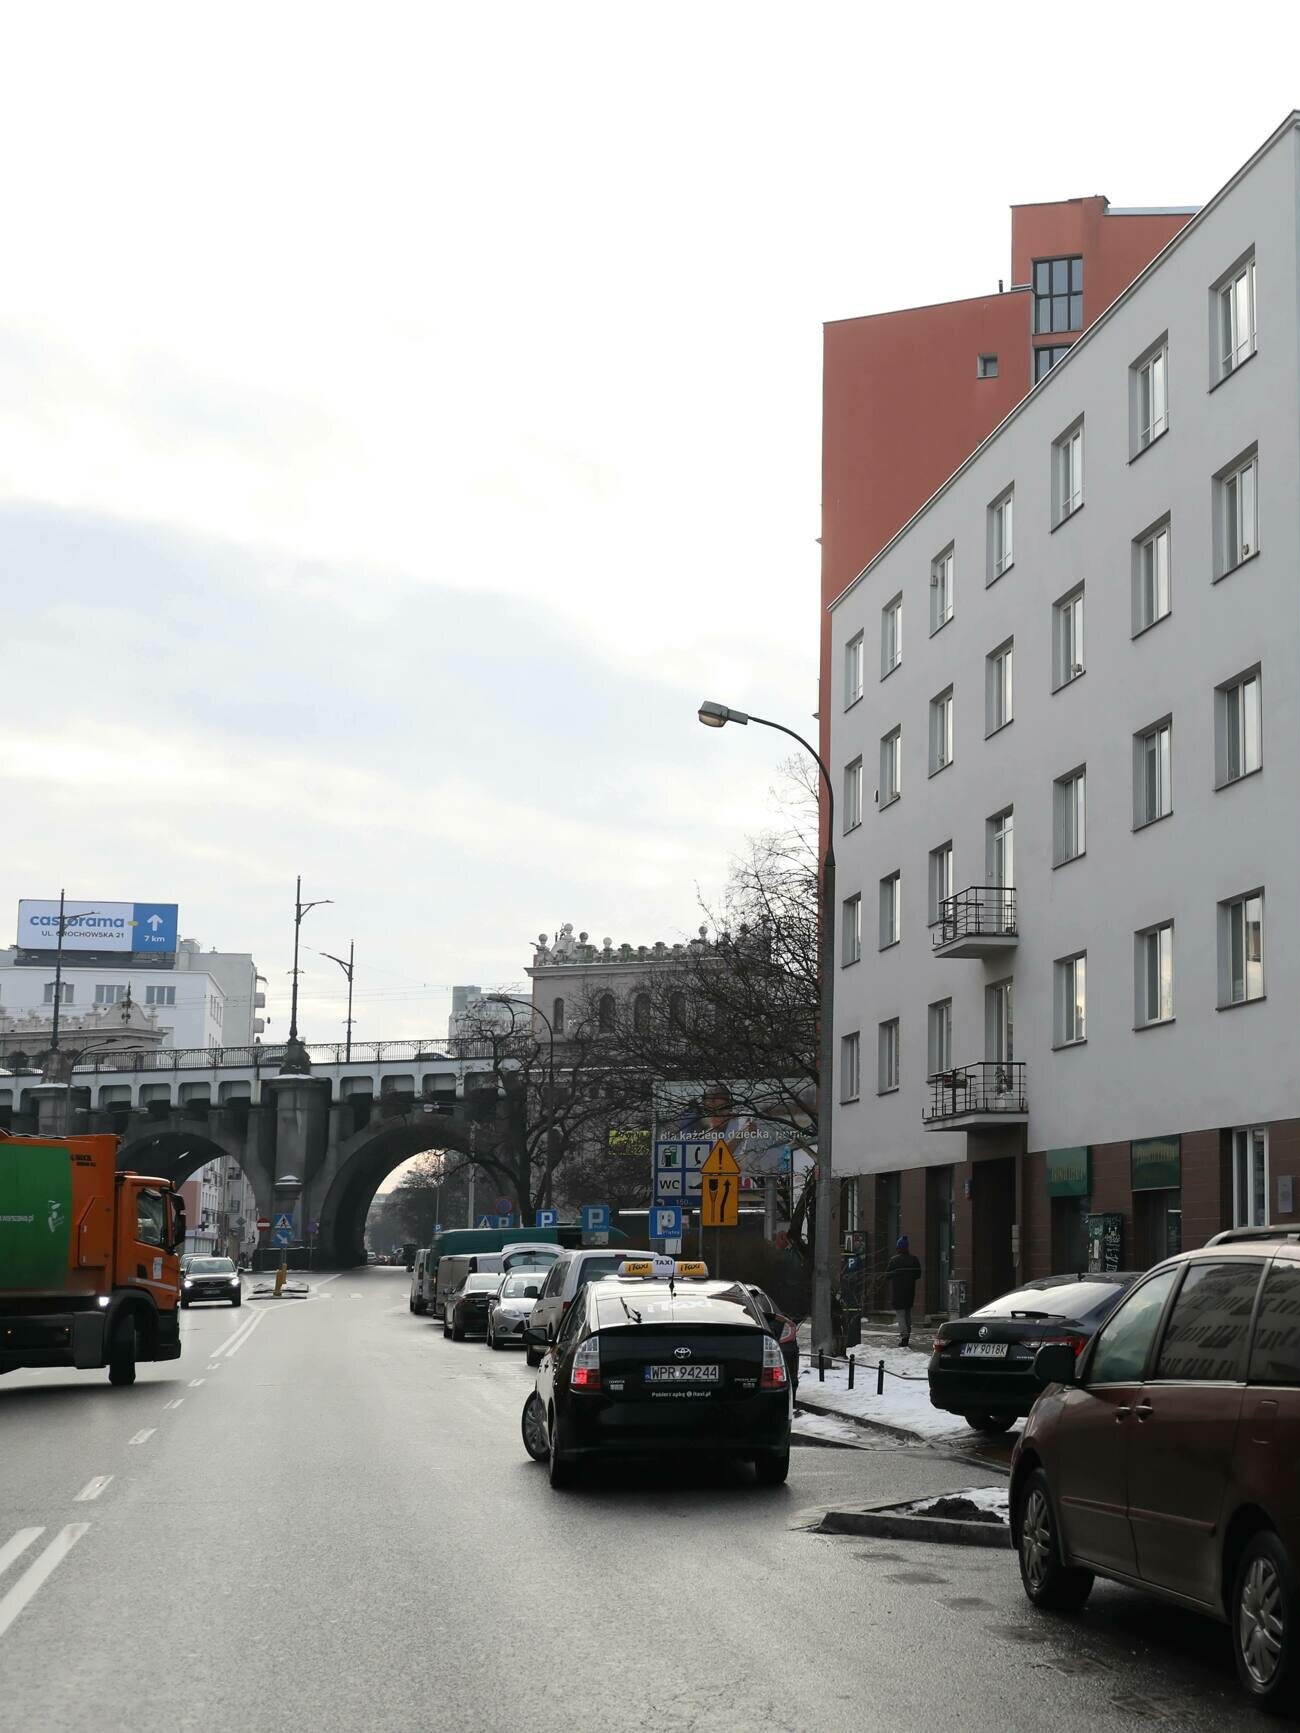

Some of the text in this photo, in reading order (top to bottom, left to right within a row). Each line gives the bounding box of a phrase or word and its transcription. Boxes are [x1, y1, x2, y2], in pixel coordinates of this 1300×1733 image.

[30, 914, 125, 928] casorama
[151, 935, 165, 943] km
[659, 1179, 680, 1190] WC
[541, 1212, 553, 1227] P
[588, 1208, 604, 1229] P
[656, 1210, 676, 1235] P
[652, 1366, 718, 1379] WPR 94244
